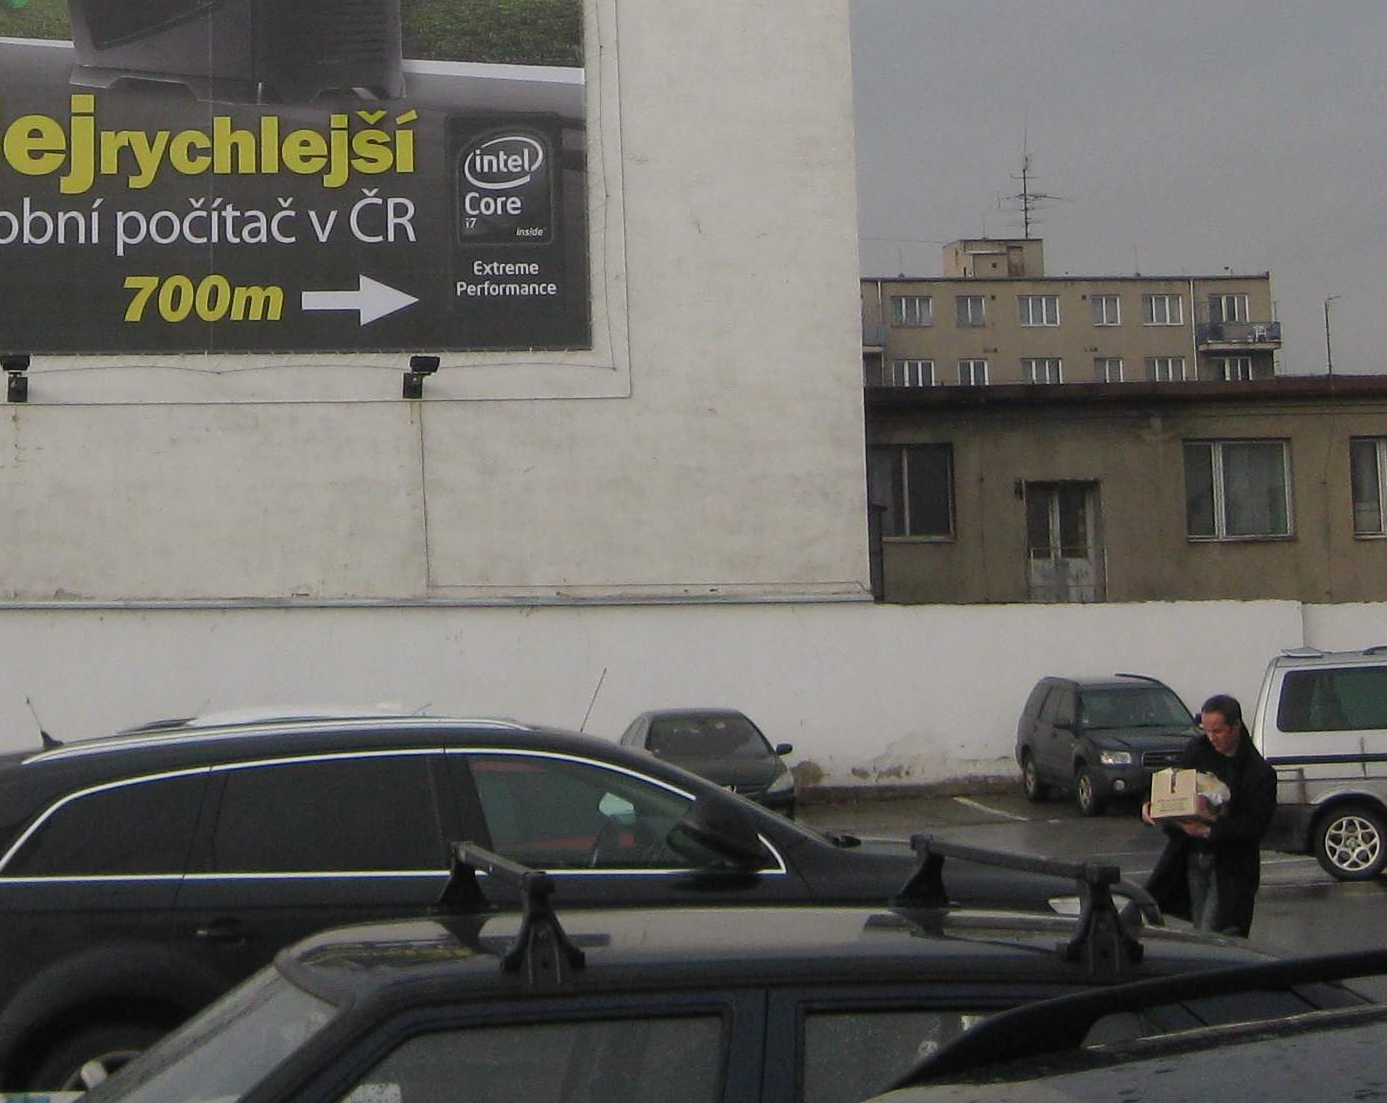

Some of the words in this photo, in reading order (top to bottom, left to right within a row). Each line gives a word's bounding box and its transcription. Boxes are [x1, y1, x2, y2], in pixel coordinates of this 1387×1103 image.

[475, 148, 531, 173] intel
[464, 192, 522, 216] Core
[116, 197, 297, 257] počítač
[307, 209, 338, 243] v
[349, 187, 417, 243] ČR
[465, 217, 477, 229] i7
[473, 260, 540, 276] Extreme
[124, 274, 285, 322] 700m
[456, 281, 558, 297] Performance
